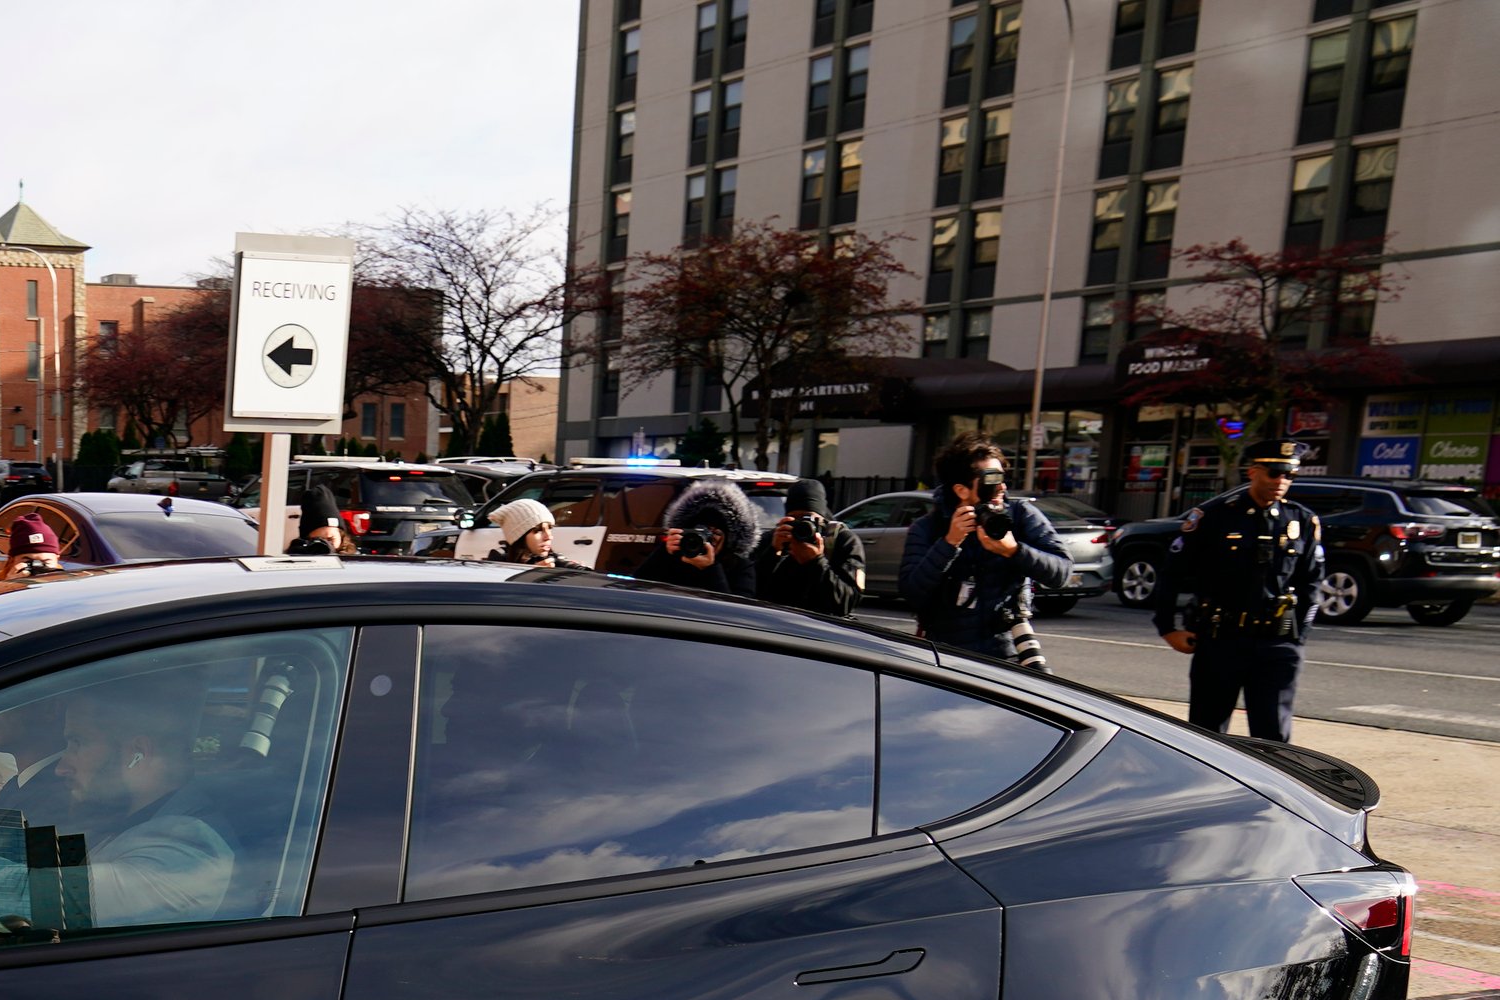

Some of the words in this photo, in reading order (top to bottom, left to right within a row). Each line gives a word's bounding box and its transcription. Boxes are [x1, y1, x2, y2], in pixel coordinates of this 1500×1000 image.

[251, 281, 336, 301] RECEIVING
[1127, 361, 1161, 376] FOOD
[1161, 357, 1212, 373] MARKET
[1372, 441, 1411, 460] Cold
[1429, 440, 1480, 459] Choice
